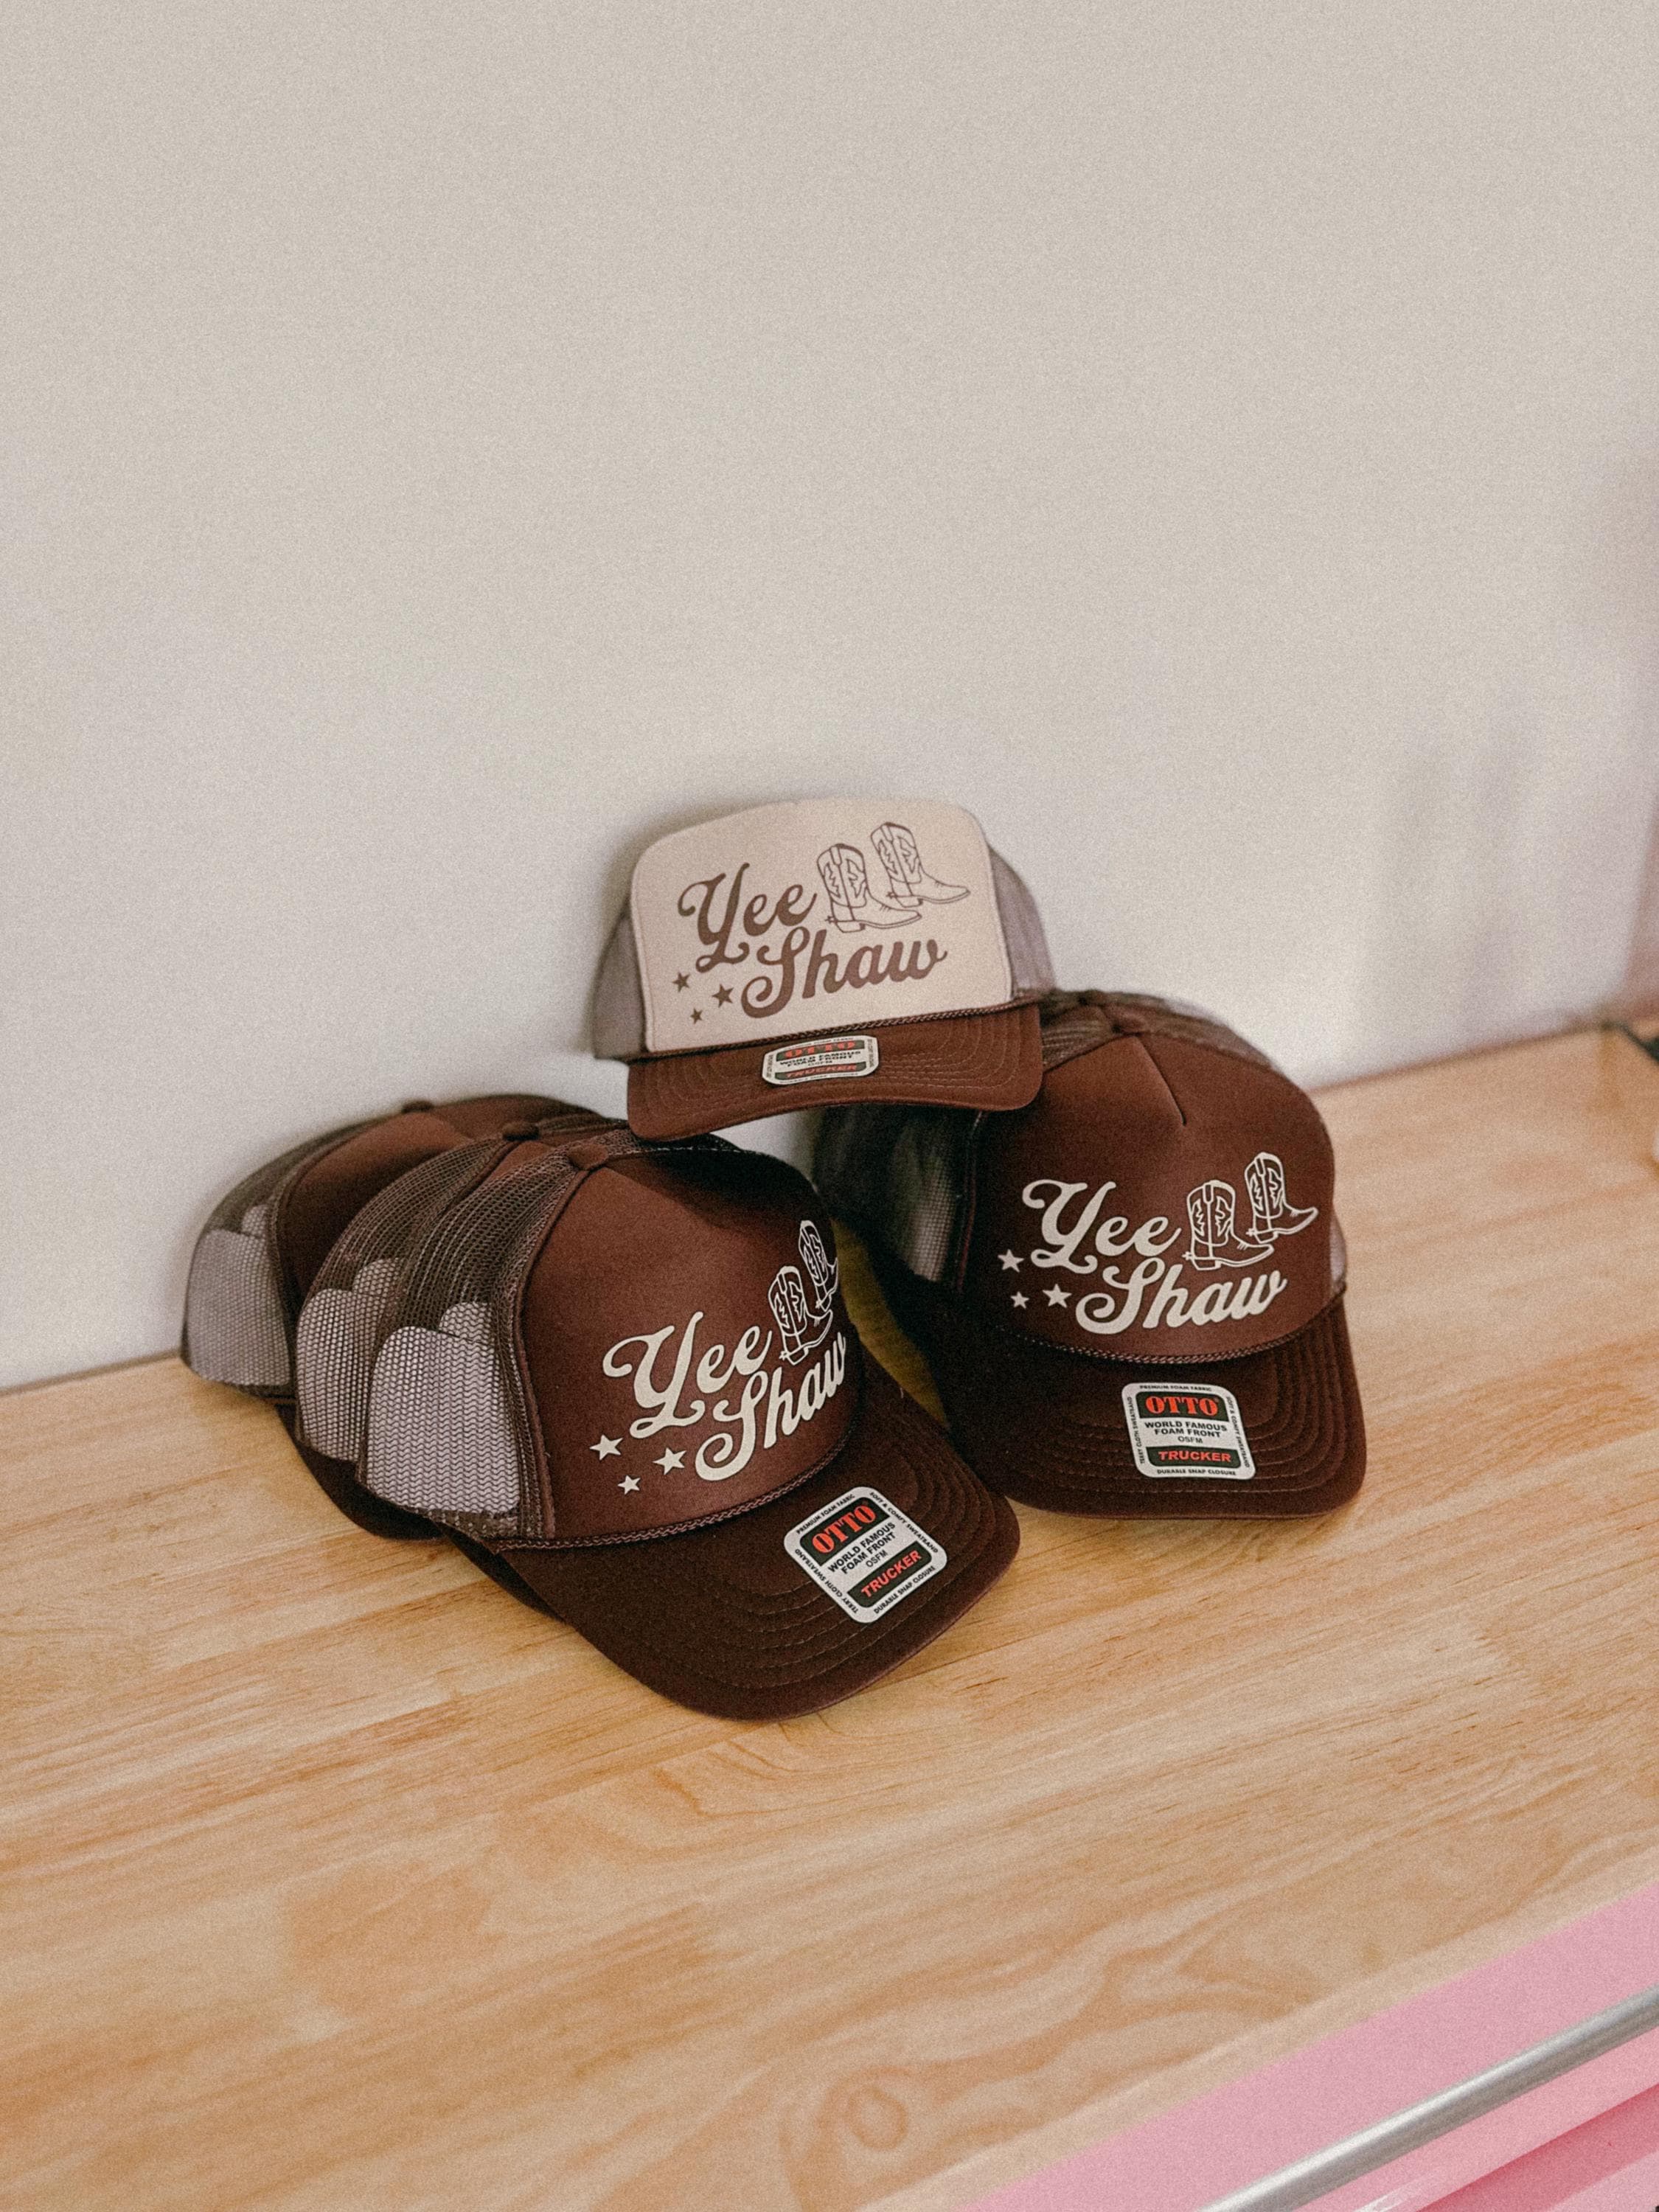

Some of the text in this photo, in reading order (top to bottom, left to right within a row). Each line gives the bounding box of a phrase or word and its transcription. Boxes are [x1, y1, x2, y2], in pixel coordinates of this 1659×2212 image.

[677, 863, 817, 973] Yee
[741, 926, 947, 1018] Shaw
[784, 1041, 855, 1058] OTTO
[1022, 1179, 1181, 1274] Yee
[1076, 1257, 1288, 1335] Shaw
[602, 1311, 773, 1439] Yee
[695, 1332, 846, 1481] Shaw
[1144, 1421, 1227, 1432] WORLD FAMOUS
[1145, 1396, 1218, 1416] OTTO
[1178, 1436, 1203, 1444] OSFM
[1188, 1429, 1221, 1438] FRONT
[1158, 1450, 1231, 1462] TRUCKER
[796, 1494, 855, 1534] PREMIUM FOAM FABRIC
[812, 1505, 876, 1553] OTTO
[869, 1492, 883, 1503] SOFT
[888, 1507, 907, 1523] COMFY
[906, 1523, 939, 1553] SWEATBAND
[795, 1548, 827, 1581] SWEATBAND
[828, 1523, 895, 1572] WORLD FAMOUS
[841, 1532, 896, 1574] FOAM FRONT
[866, 1549, 888, 1568] OSFM
[825, 1581, 843, 1598] CLOTH
[861, 1550, 922, 1597] TRUCKER
[874, 1566, 936, 1613] DURABLE SNAP CLOSURE
